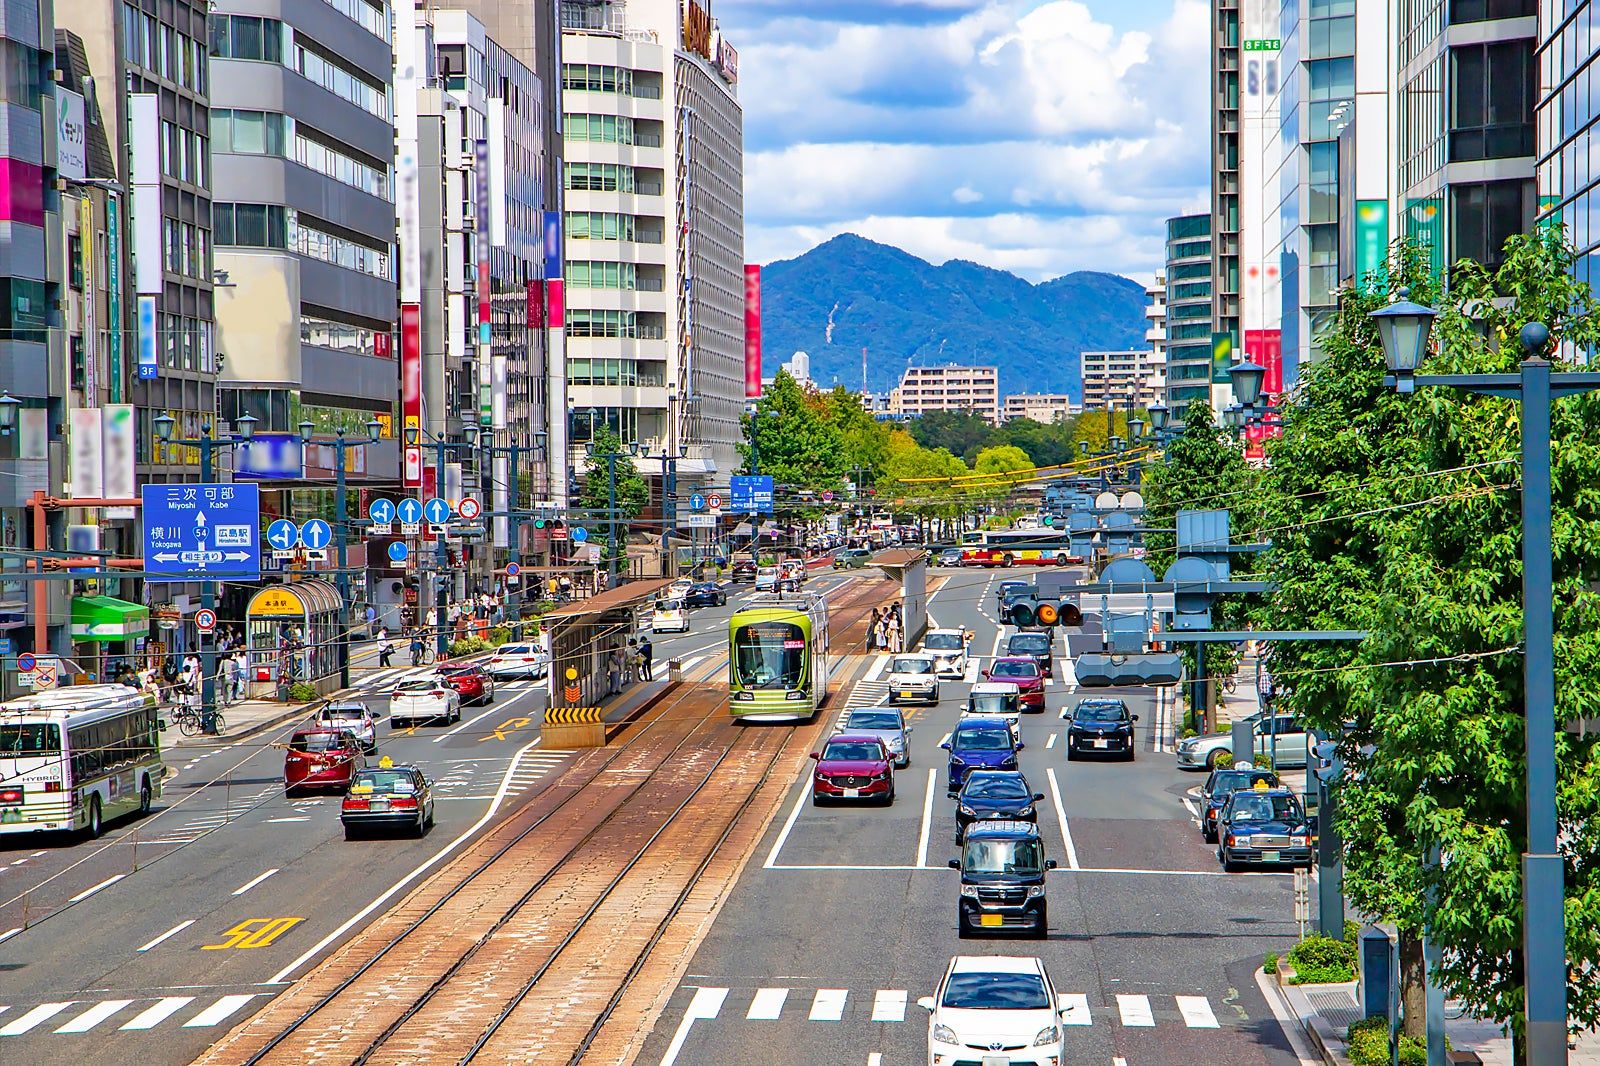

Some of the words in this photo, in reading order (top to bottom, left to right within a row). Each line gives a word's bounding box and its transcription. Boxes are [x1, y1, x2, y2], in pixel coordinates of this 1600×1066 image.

[1246, 41, 1260, 49] 8F
[141, 366, 154, 376] 3F
[167, 487, 197, 501] 三次
[204, 486, 234, 501] 可部
[168, 502, 196, 511] Miyoshi
[209, 501, 229, 509] Kabe
[150, 526, 181, 540] 横川
[195, 529, 207, 537] 54
[218, 528, 248, 538] 広島駅
[150, 540, 182, 549] Yokogawa
[184, 551, 219, 561] 相生通り
[200, 917, 306, 950] 50
